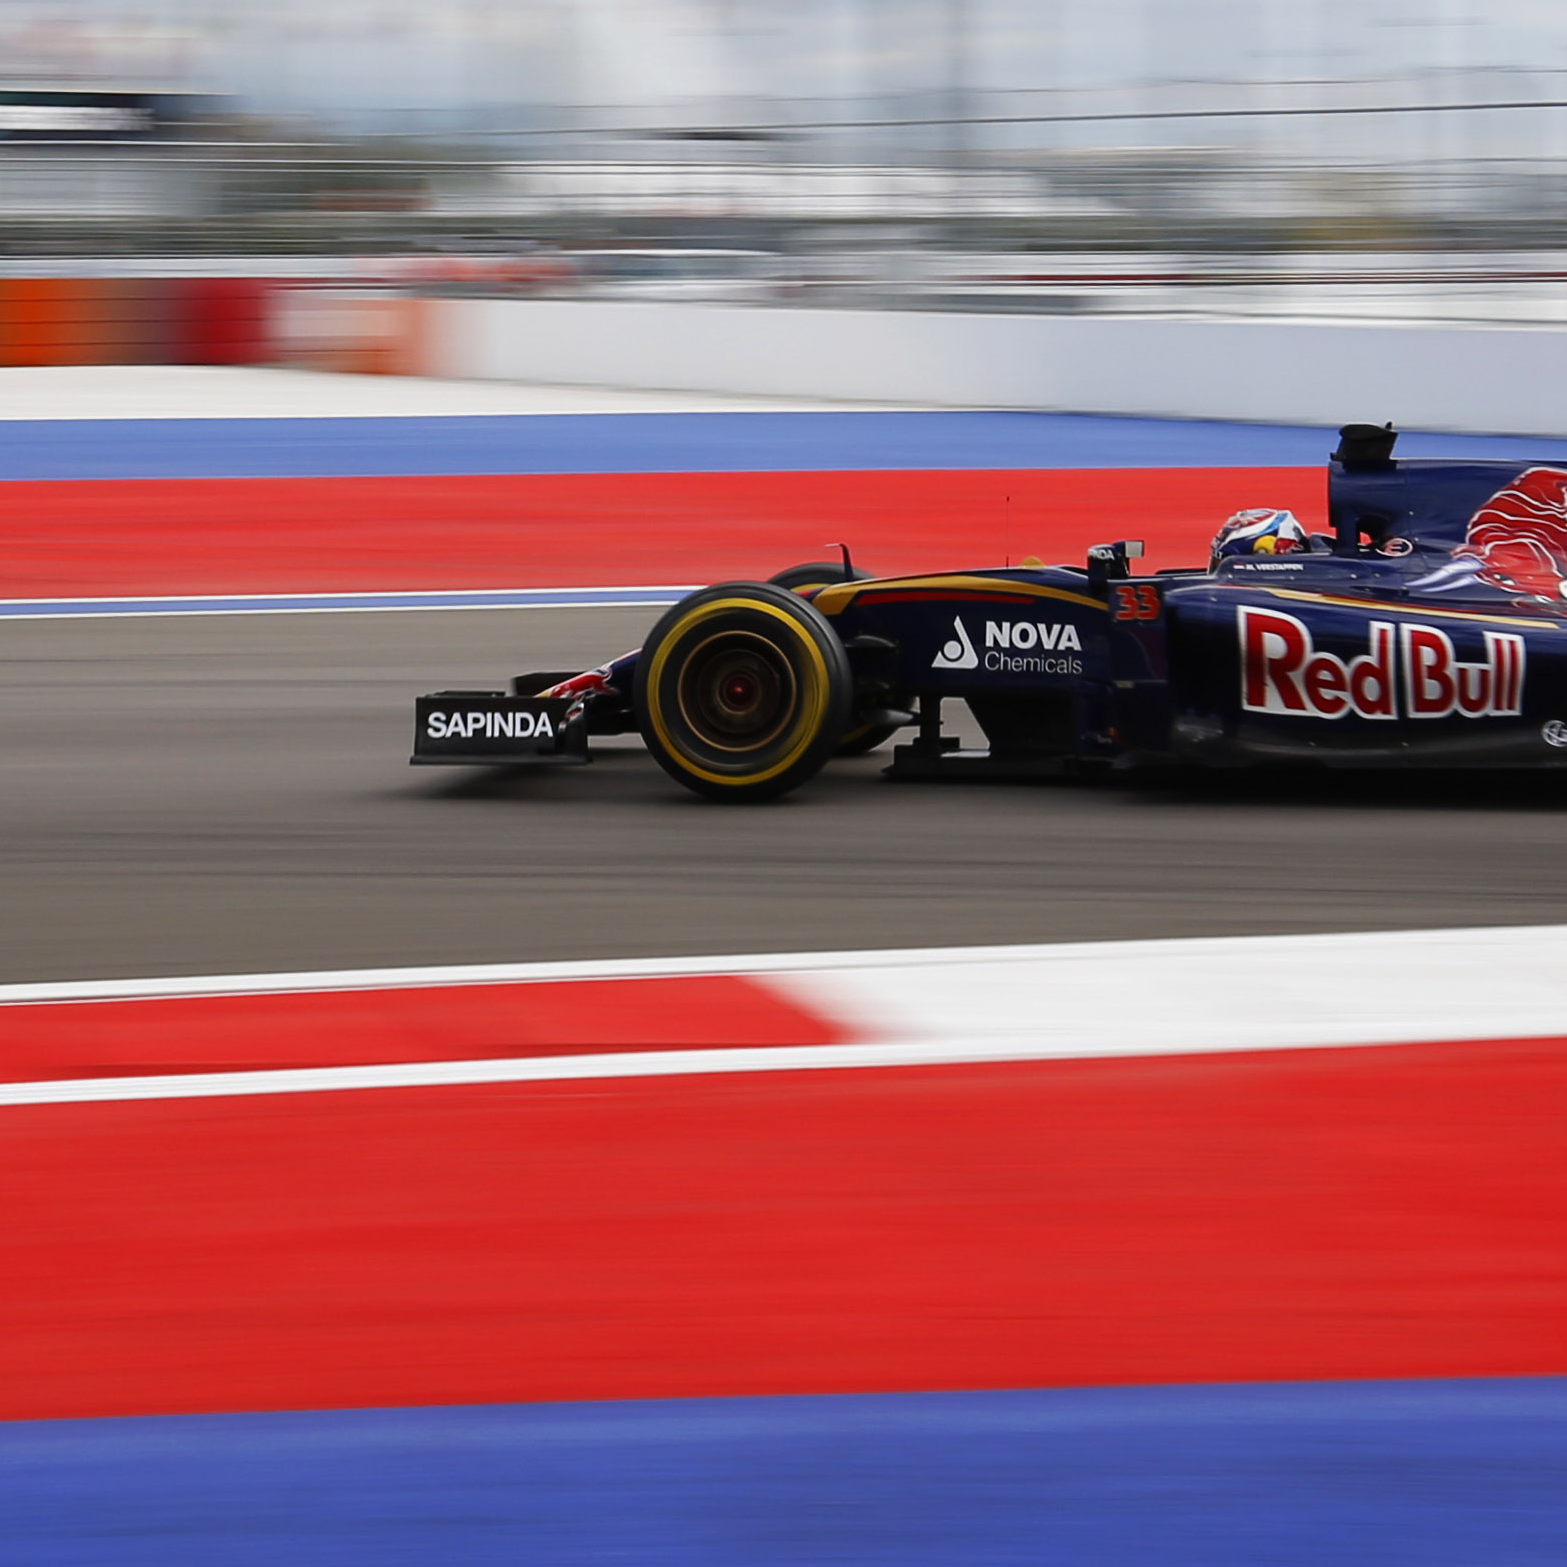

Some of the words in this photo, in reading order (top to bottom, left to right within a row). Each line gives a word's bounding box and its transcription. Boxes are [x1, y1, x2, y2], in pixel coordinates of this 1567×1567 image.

[1115, 585, 1160, 620] 33
[985, 621, 1082, 651] NOVA
[985, 651, 1082, 674] Chemicals
[1240, 607, 1396, 718] Red
[1403, 625, 1523, 717] Bull
[427, 712, 553, 738] SAPINDA
